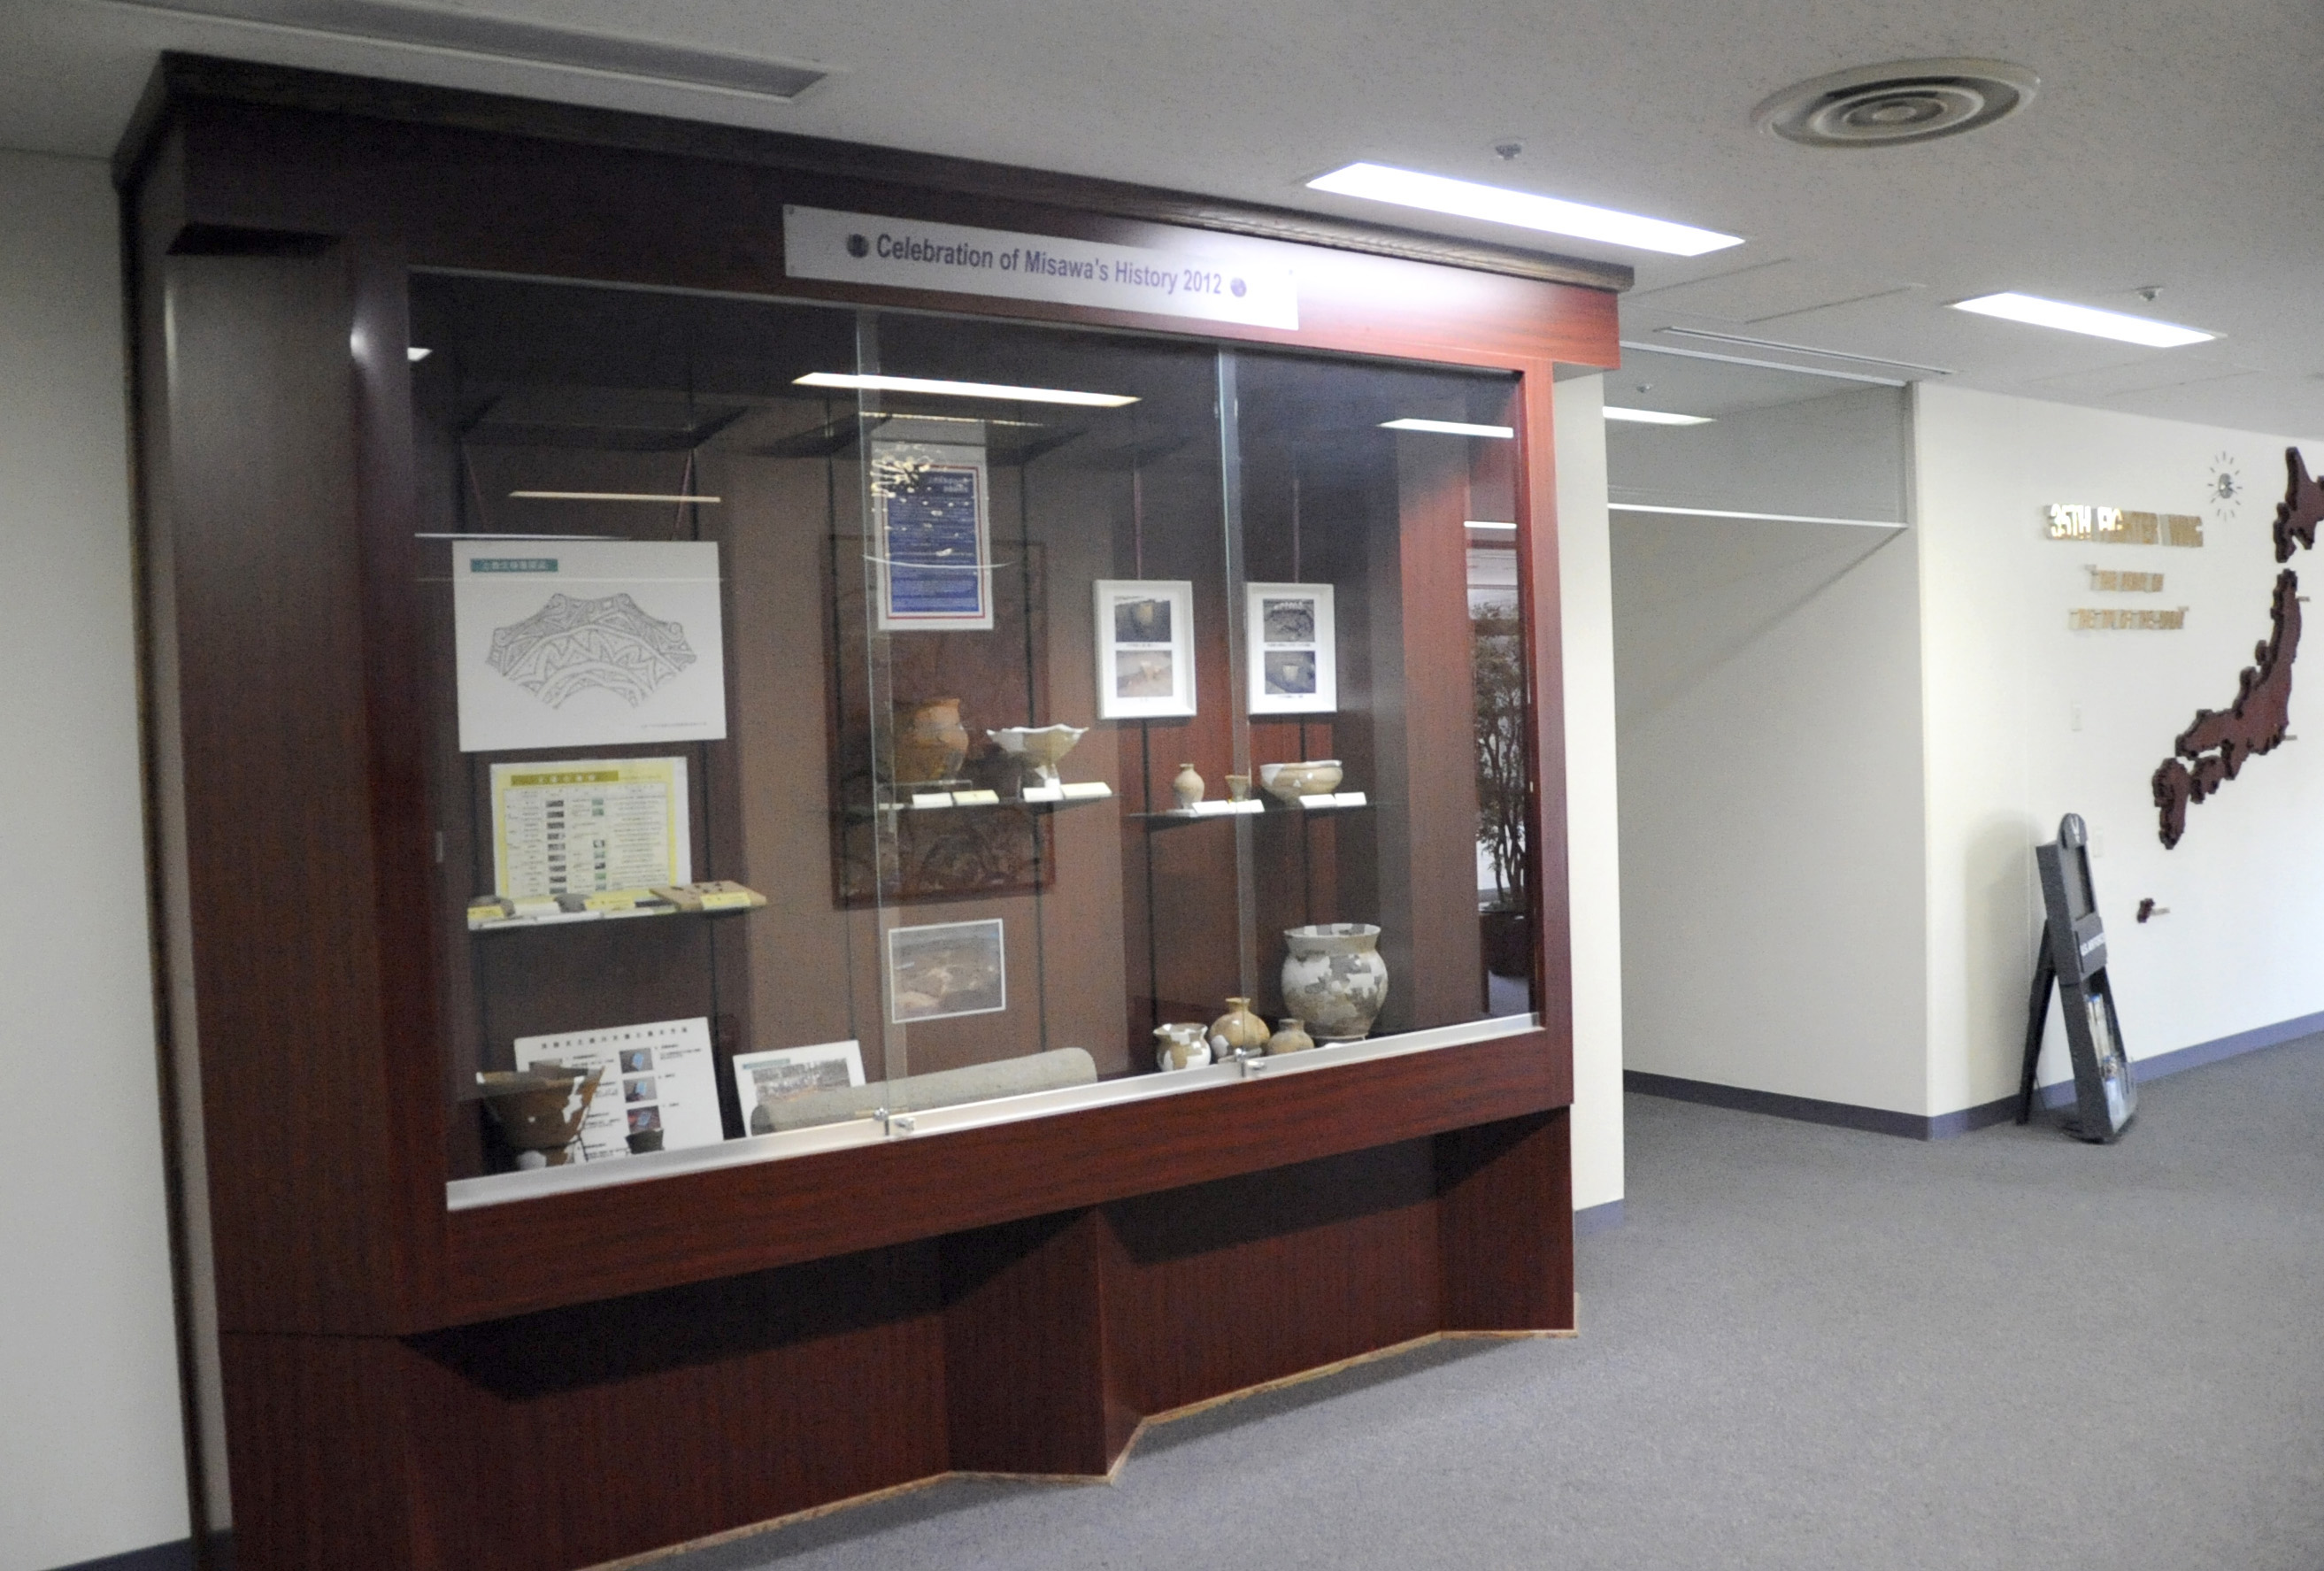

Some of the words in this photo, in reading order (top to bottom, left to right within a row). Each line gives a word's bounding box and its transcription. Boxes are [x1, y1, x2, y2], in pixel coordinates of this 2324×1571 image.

[876, 233, 993, 269] Celebration
[999, 248, 1020, 271] of
[1024, 249, 1109, 281] Misawa's
[1114, 259, 1178, 295] History
[1183, 269, 1221, 294] 2012
